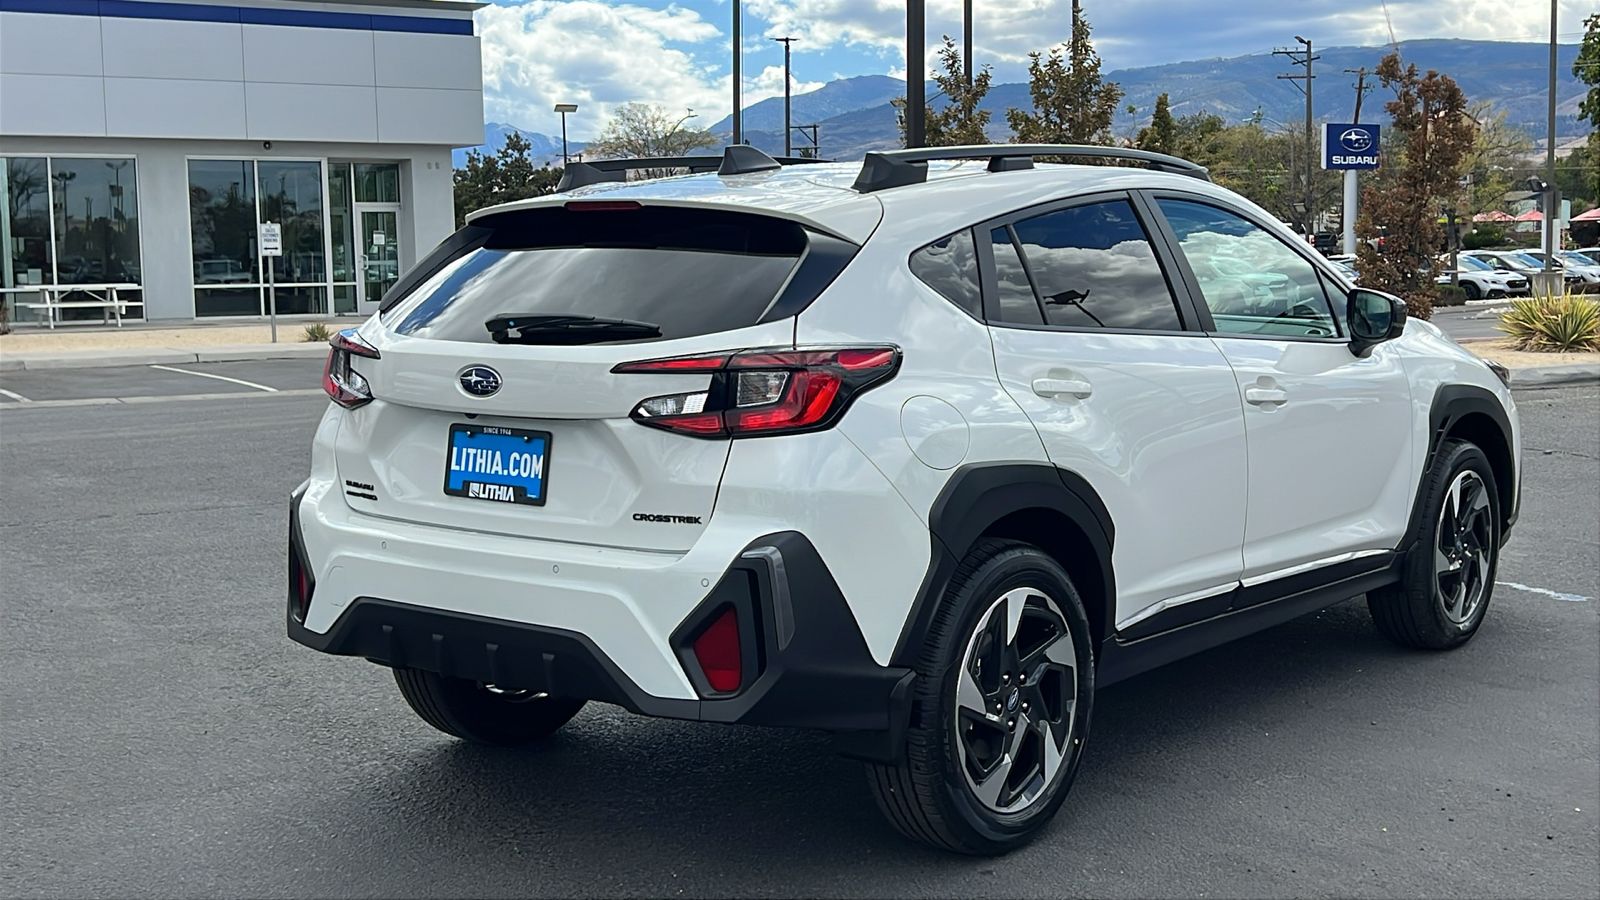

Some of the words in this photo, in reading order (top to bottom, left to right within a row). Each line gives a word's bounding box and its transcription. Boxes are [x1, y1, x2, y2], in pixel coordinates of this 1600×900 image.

[1332, 155, 1377, 165] SUBARU
[483, 427, 499, 435] SINCE
[451, 446, 544, 480] LITHIA.COM
[346, 480, 375, 491] SUBARU
[479, 483, 515, 502] LITHIA
[632, 513, 702, 525] CROSSTREK
